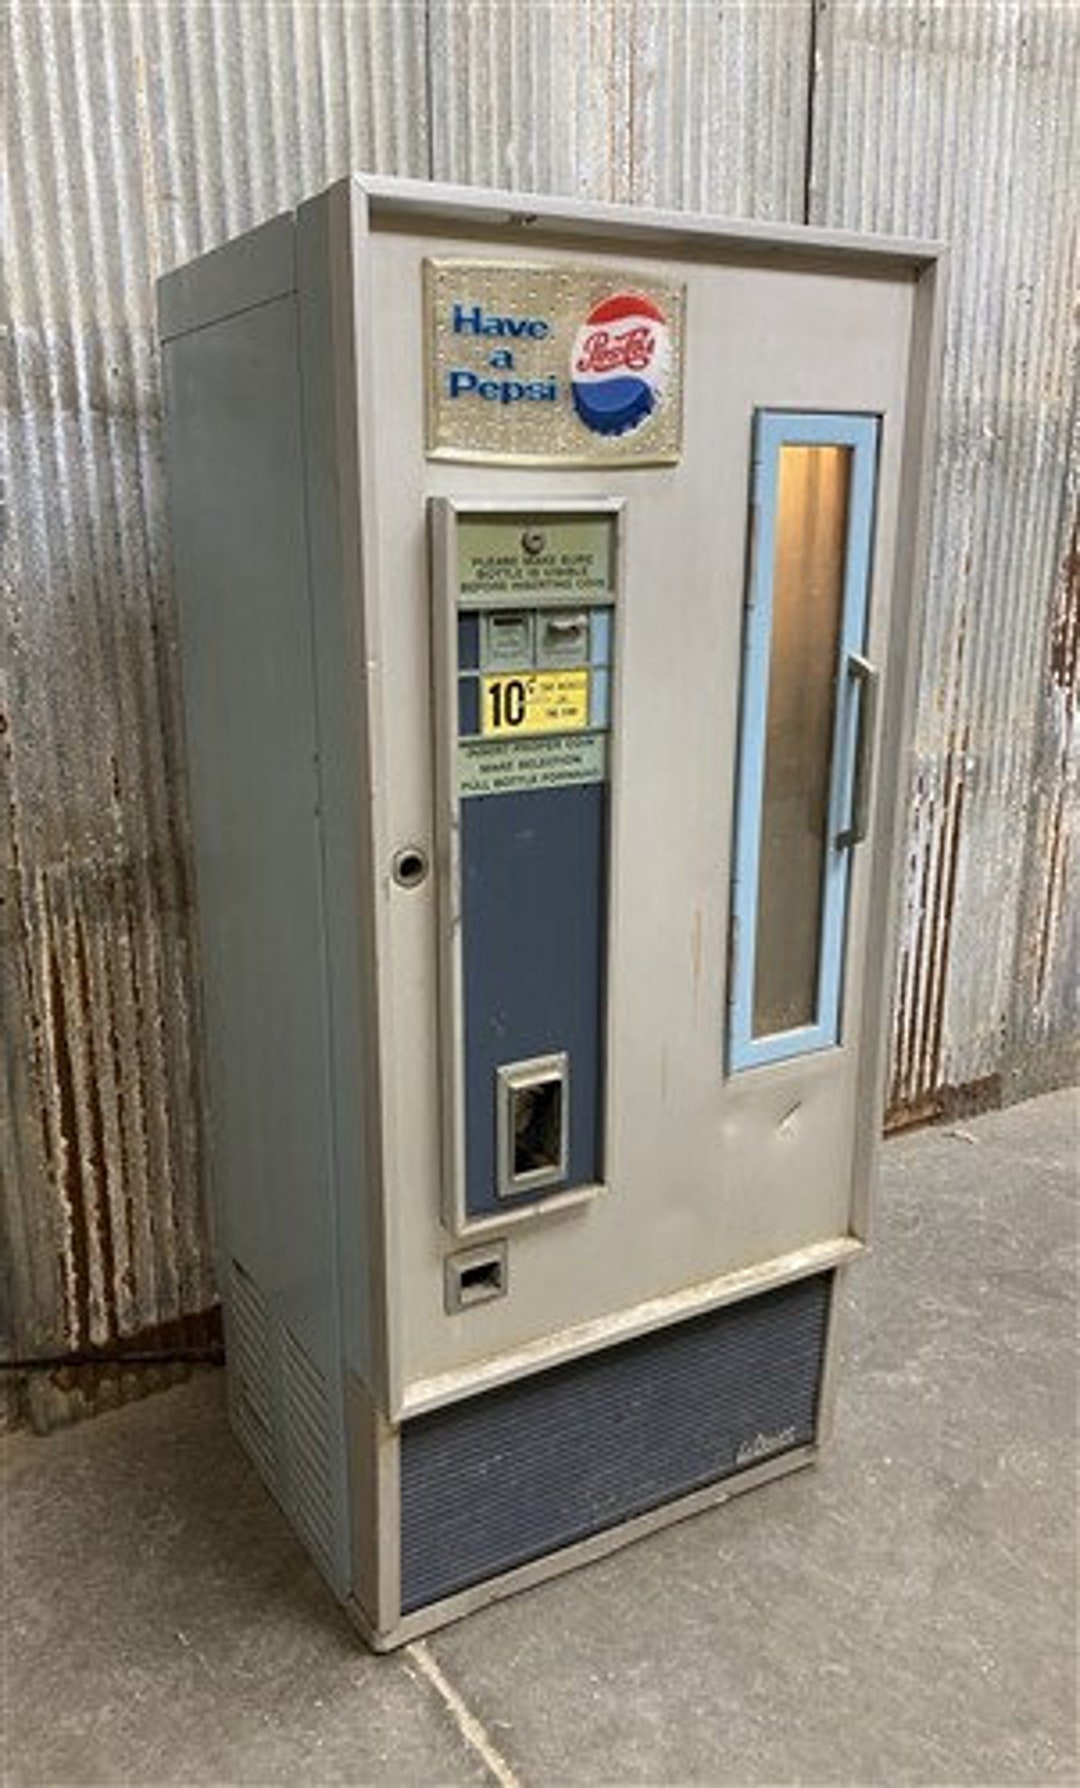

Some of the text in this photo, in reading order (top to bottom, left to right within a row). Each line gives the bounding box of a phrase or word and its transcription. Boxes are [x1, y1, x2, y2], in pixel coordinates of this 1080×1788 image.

[453, 304, 549, 340] Have
[489, 349, 514, 369] a
[449, 371, 557, 405] Pepsi
